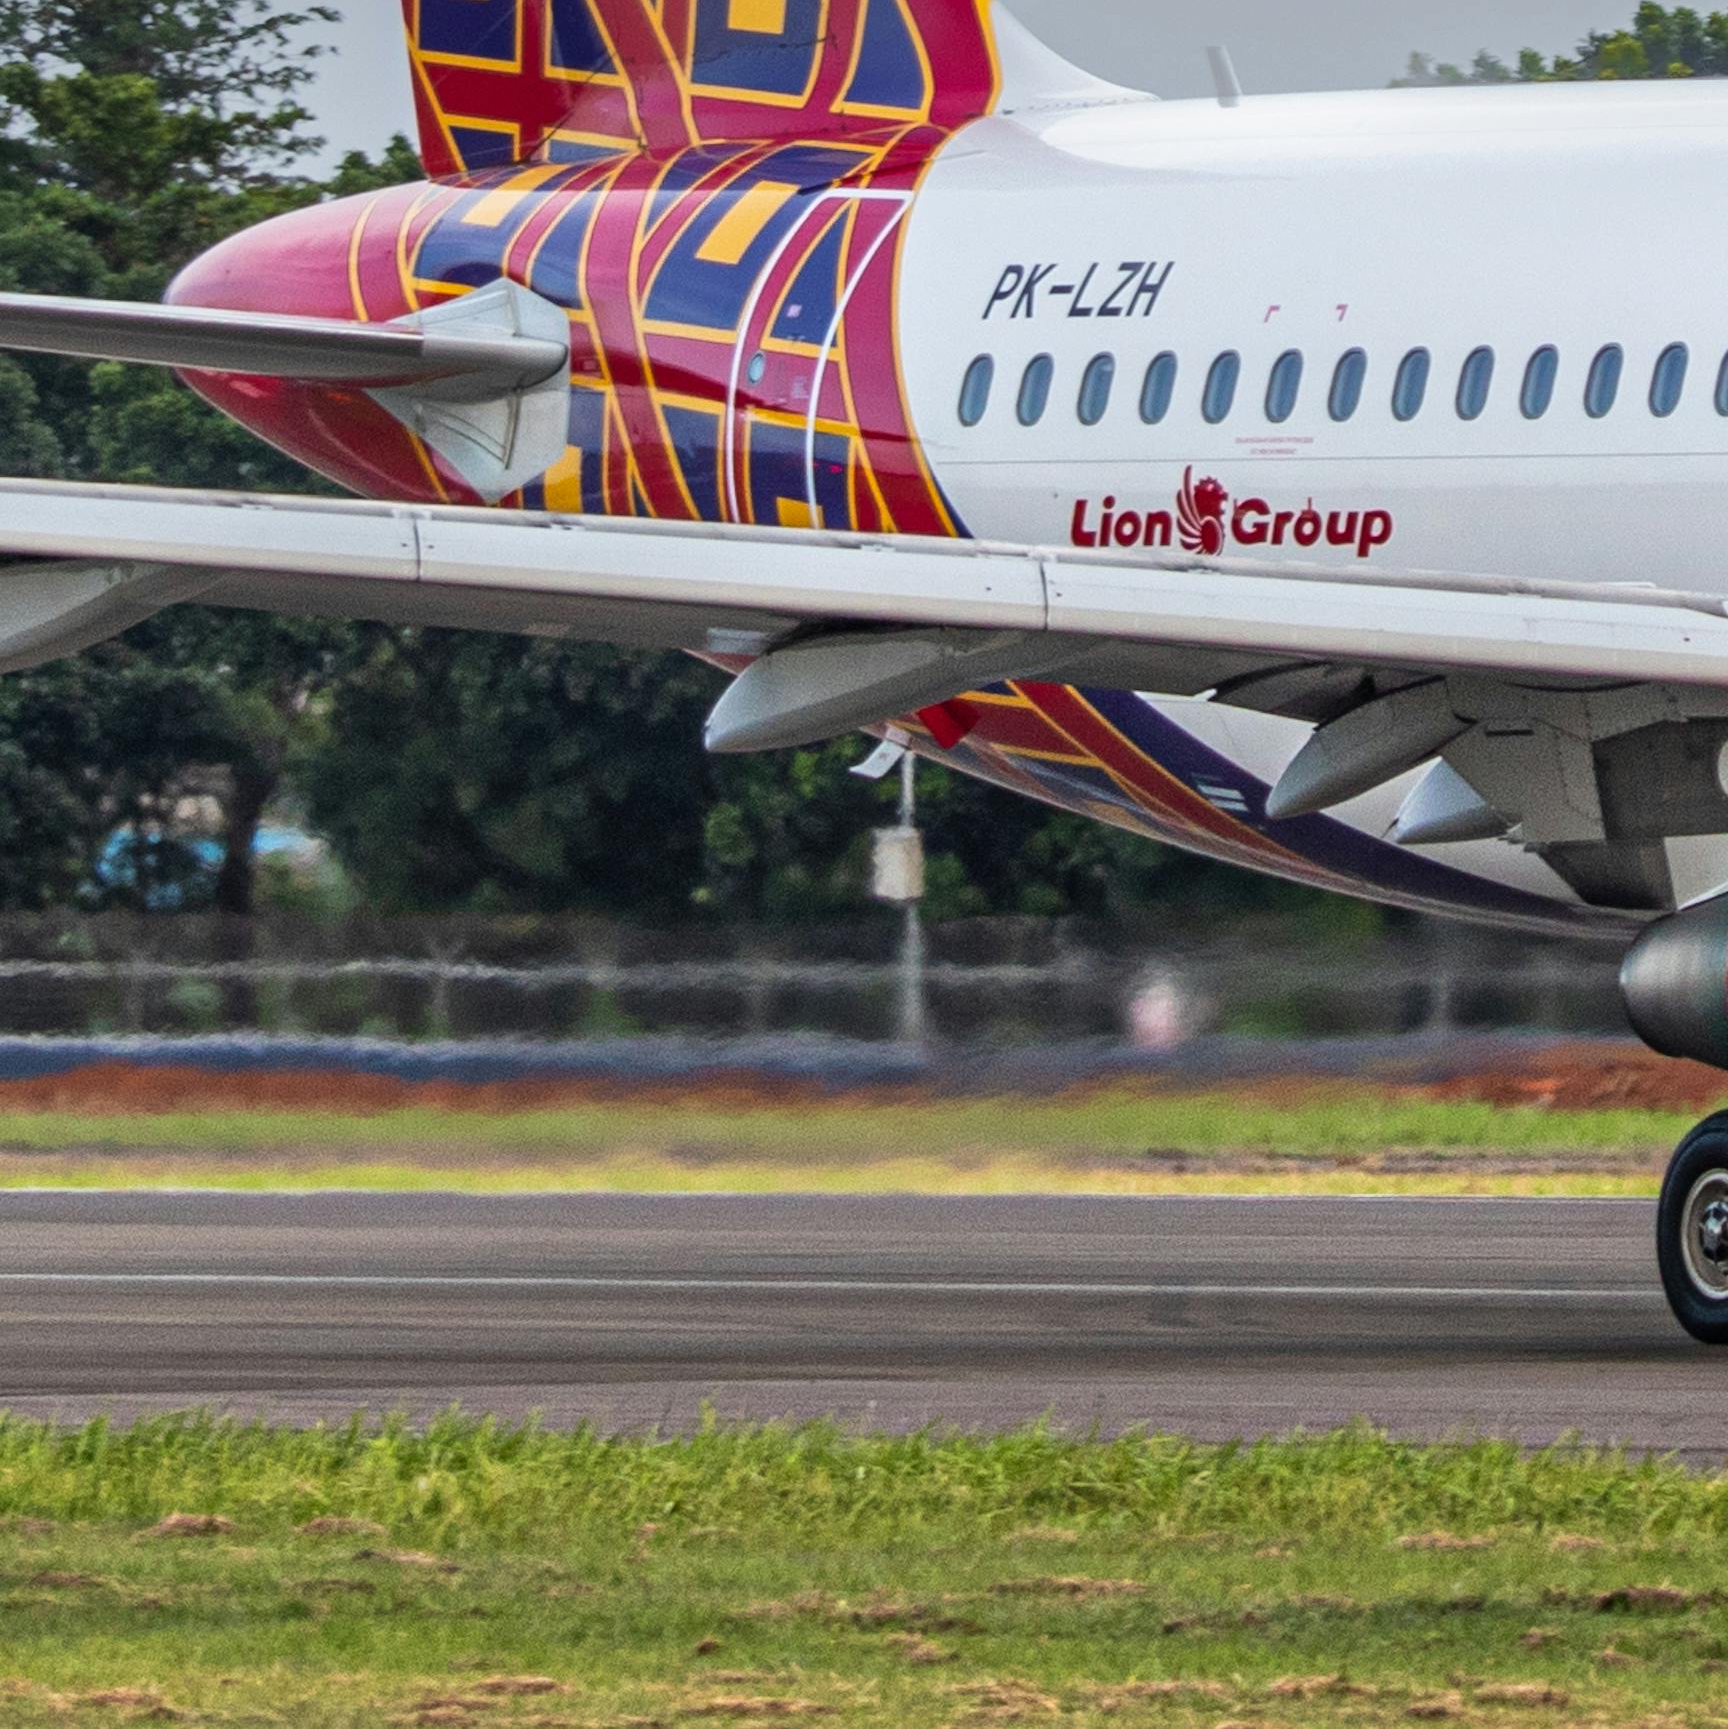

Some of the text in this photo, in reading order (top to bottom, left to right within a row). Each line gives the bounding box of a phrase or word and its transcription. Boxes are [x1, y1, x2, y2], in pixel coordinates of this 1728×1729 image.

[981, 260, 1175, 321] PK-LZH
[1070, 495, 1394, 558] Lion Group
